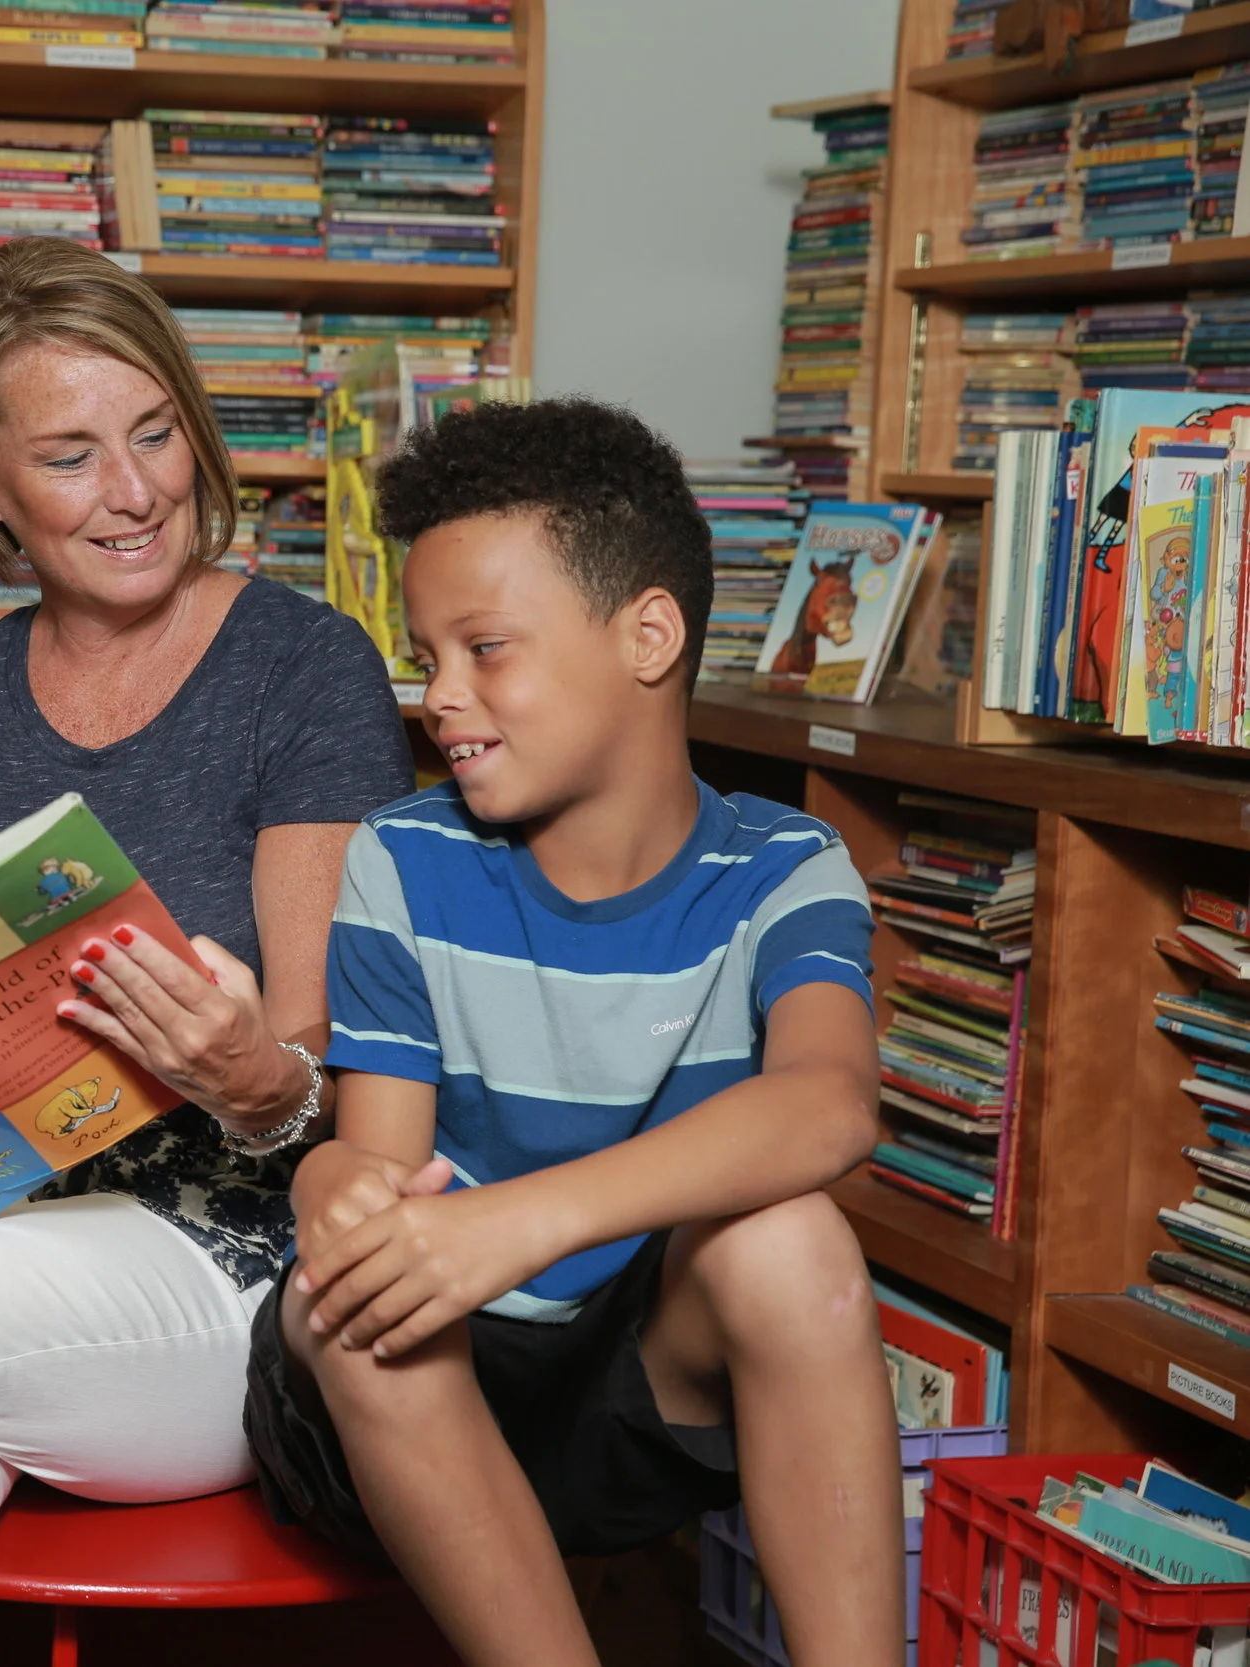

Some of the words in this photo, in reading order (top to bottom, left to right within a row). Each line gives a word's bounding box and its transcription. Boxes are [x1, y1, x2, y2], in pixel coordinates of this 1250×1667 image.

[34, 944, 64, 972] of
[650, 1018, 685, 1036] Calvin
[1171, 1371, 1204, 1398] PICTURE
[1205, 1389, 1233, 1412] BOOKS
[1021, 1588, 1070, 1619] FRAES
